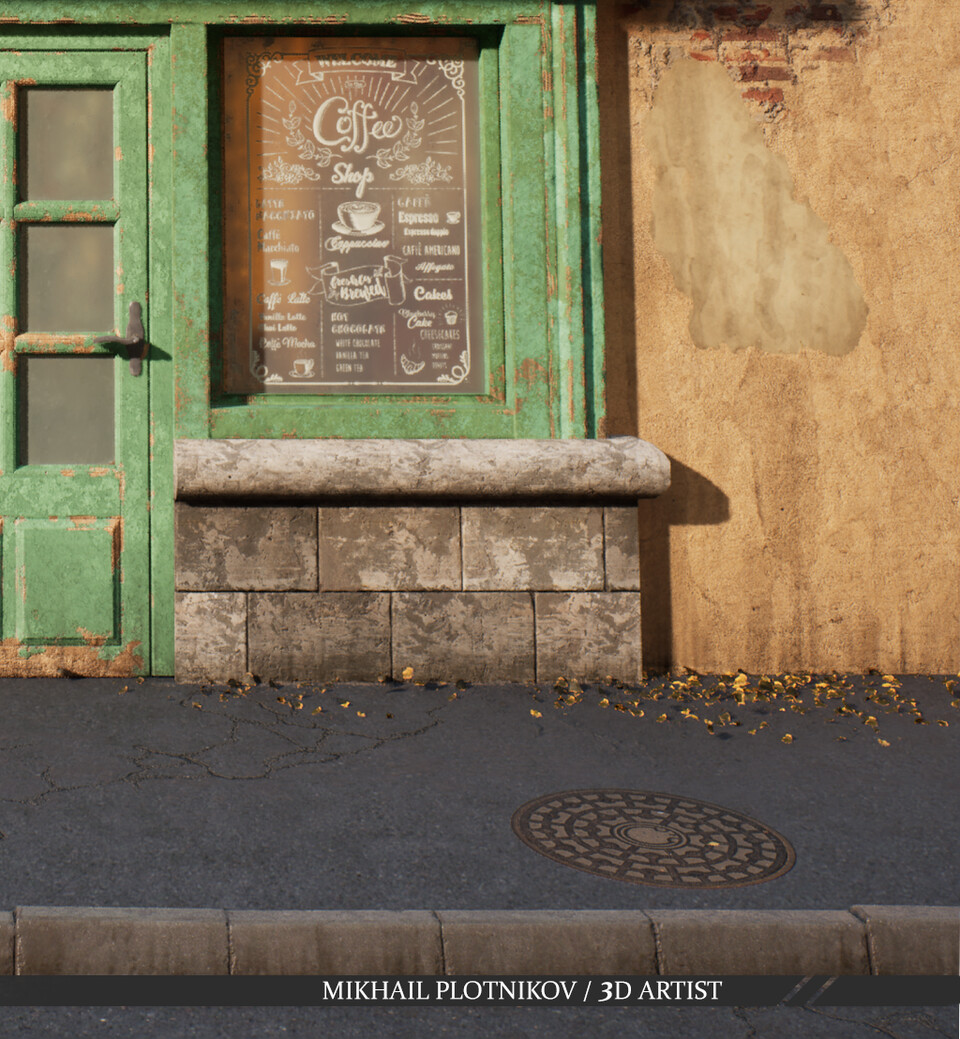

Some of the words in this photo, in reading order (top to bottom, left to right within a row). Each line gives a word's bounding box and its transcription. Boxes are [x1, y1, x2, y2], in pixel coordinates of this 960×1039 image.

[312, 96, 403, 155] Coffee
[331, 162, 375, 199] Shop
[398, 211, 439, 225] Espresso
[324, 236, 390, 254] Cappuccino
[424, 245, 461, 256] AMERICANO
[414, 261, 455, 274] Affogato
[413, 286, 454, 301] Cakes
[287, 312, 307, 321] Latte
[406, 316, 433, 329] Cake
[277, 323, 298, 332] Latte
